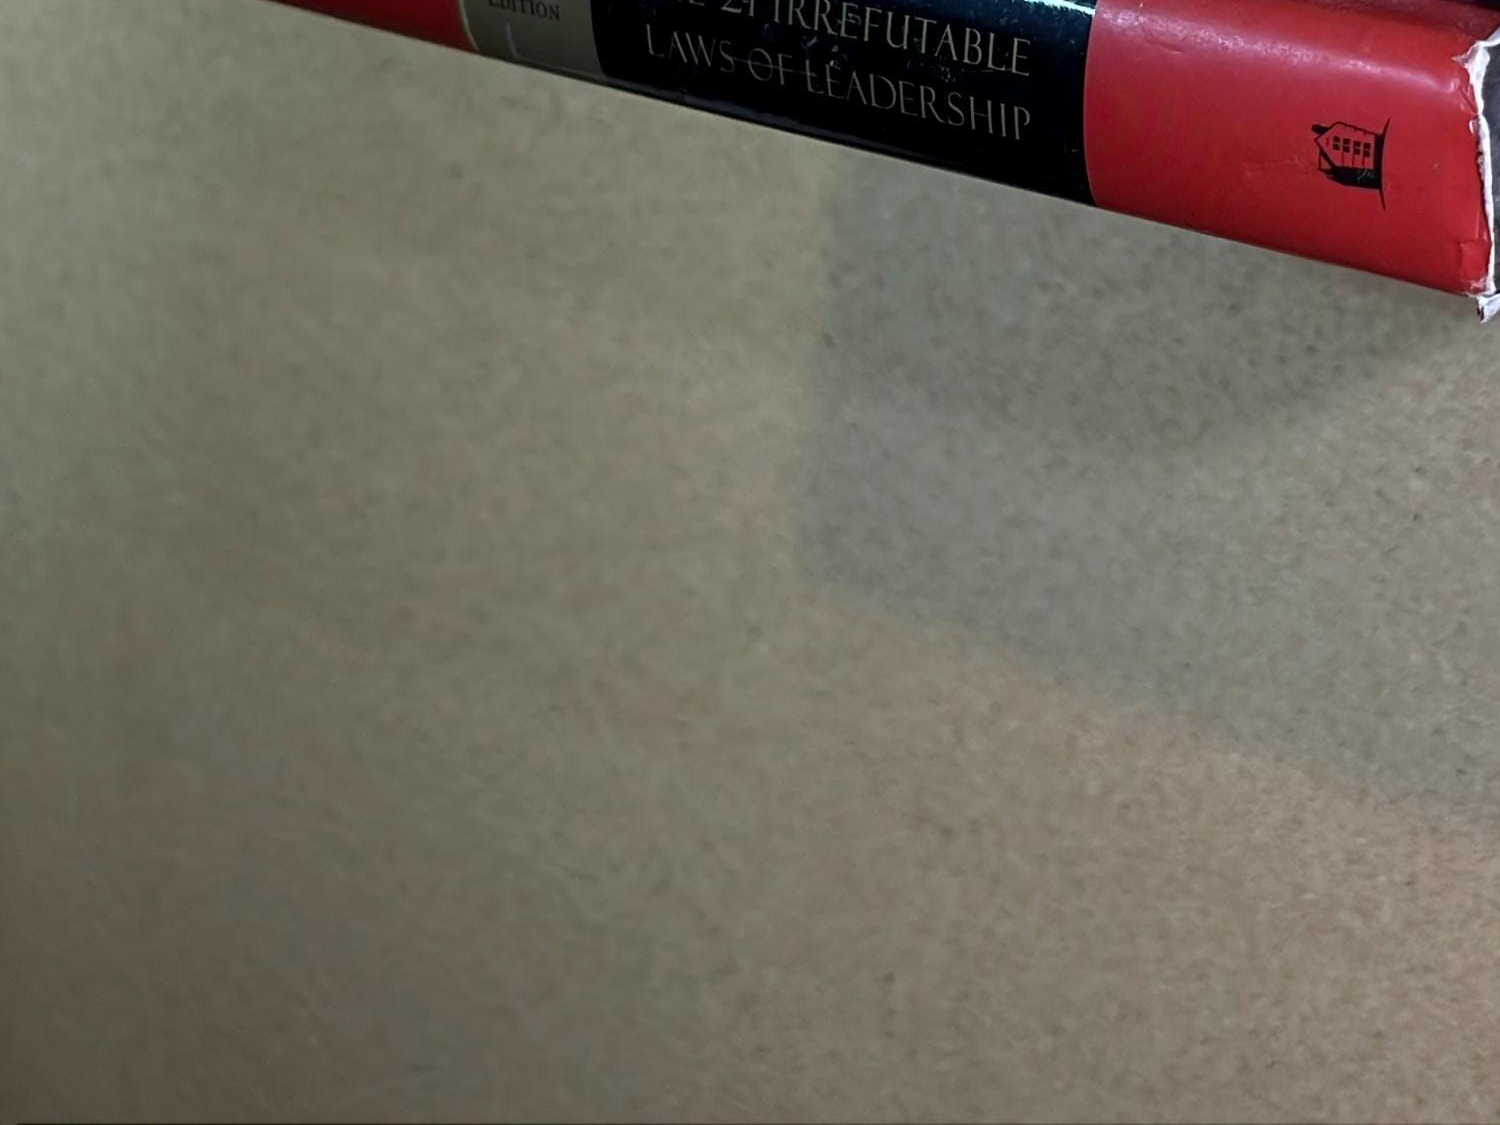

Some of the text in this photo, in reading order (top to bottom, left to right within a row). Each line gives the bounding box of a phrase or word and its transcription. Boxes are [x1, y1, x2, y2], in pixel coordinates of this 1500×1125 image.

[645, 23, 1031, 141] LAWS OF LEADERSHIP
